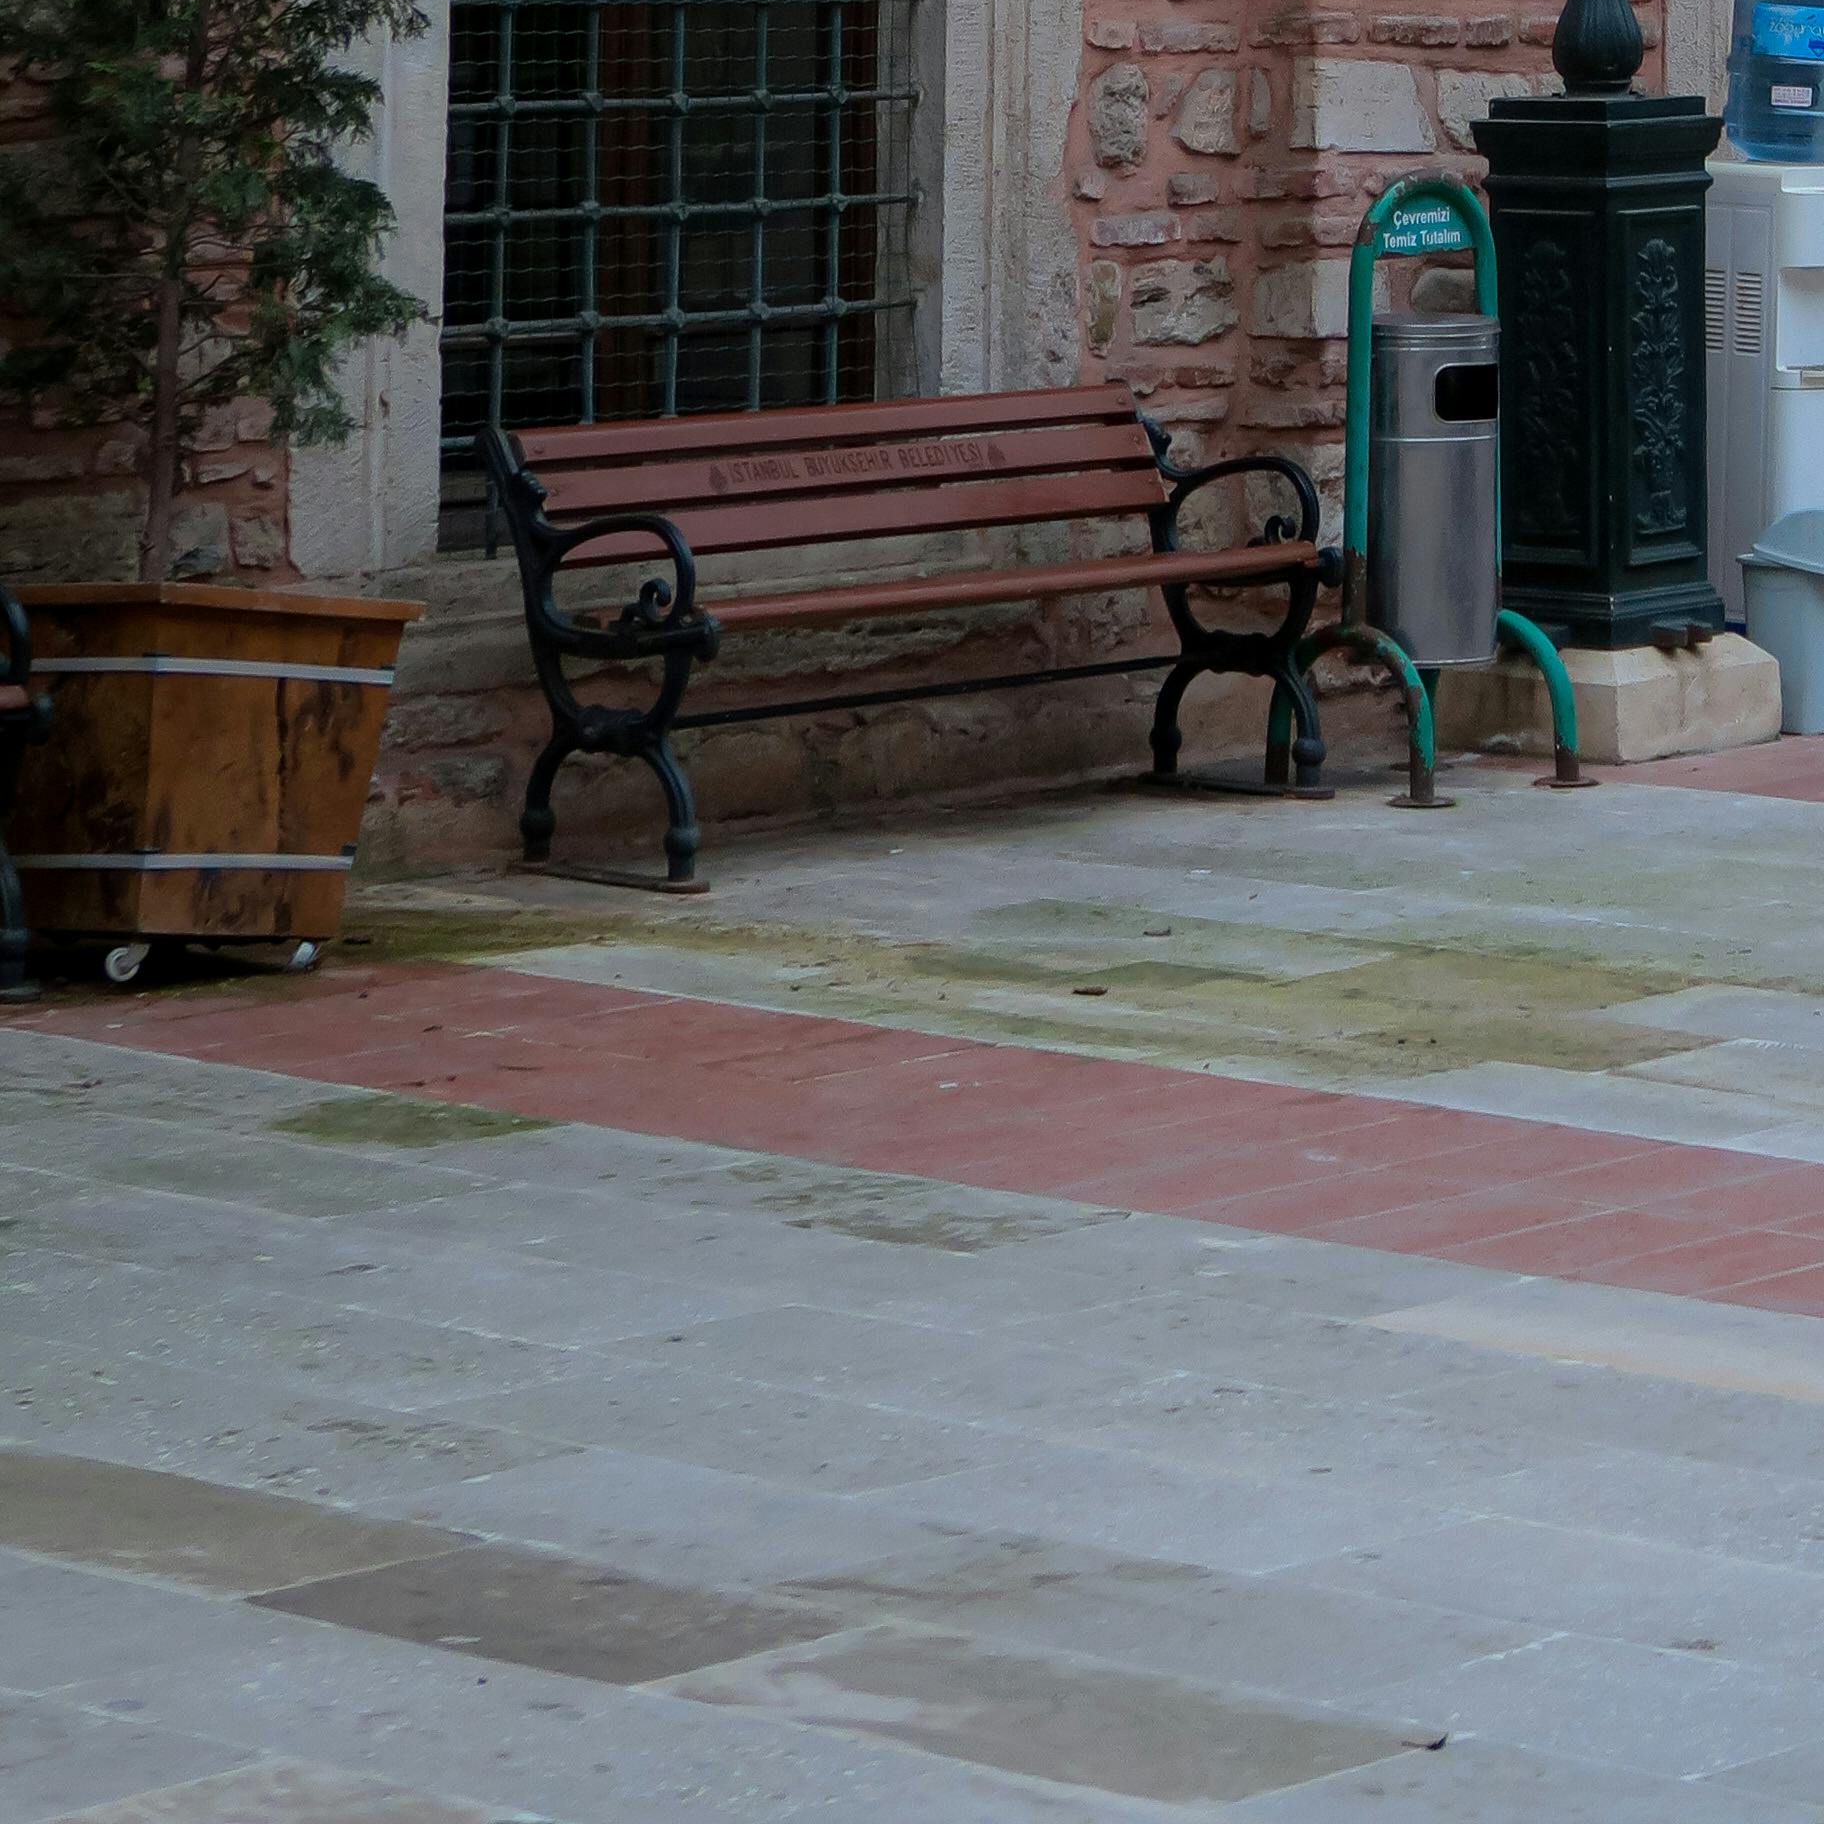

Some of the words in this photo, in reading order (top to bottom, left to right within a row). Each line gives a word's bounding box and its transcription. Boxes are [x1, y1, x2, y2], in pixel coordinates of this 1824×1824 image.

[1393, 206, 1450, 230] Çevremizi
[1383, 231, 1417, 248] Temiz
[1420, 229, 1460, 245] Tutalım
